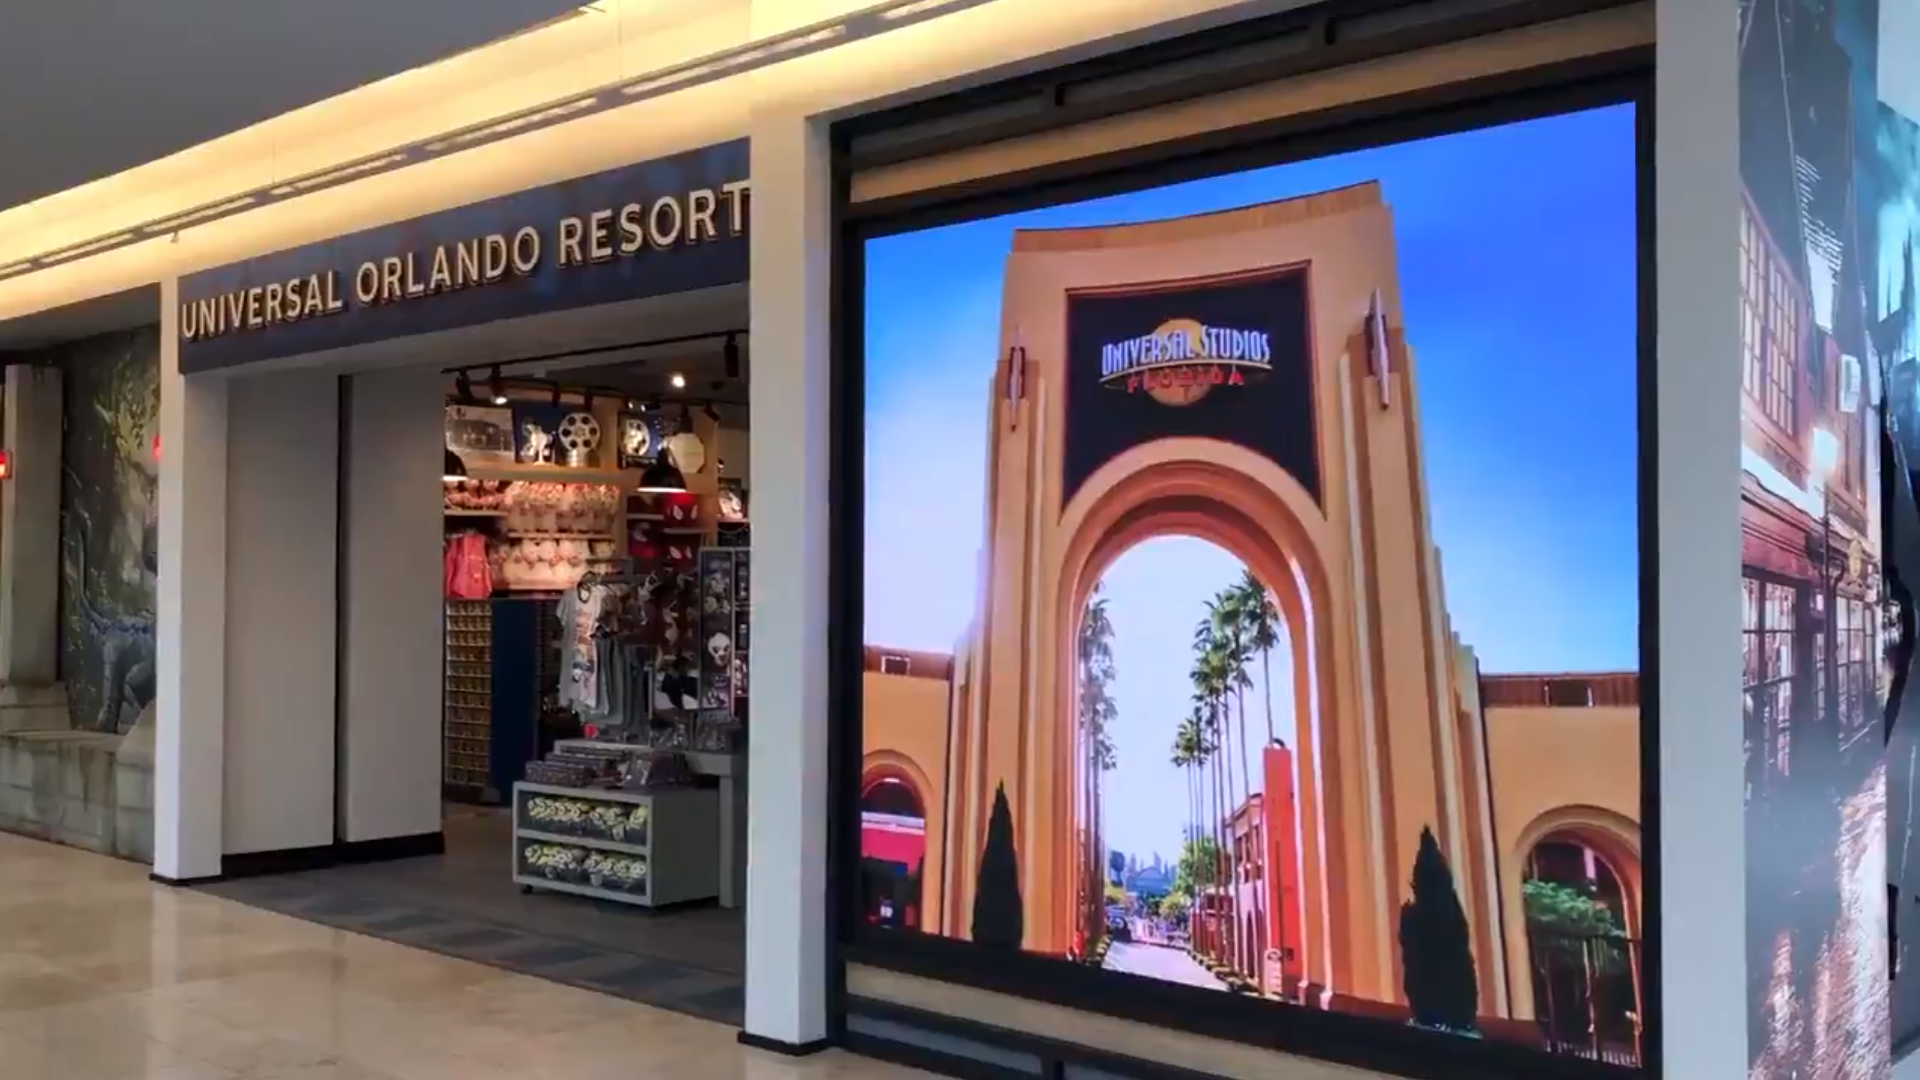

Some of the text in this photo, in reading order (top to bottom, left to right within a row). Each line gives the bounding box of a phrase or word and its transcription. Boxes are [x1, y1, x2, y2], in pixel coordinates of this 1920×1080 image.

[181, 179, 750, 340] UNIVERSAL ORLANDO RESORT
[1101, 324, 1271, 376] UNIVERSAL STUDIOS
